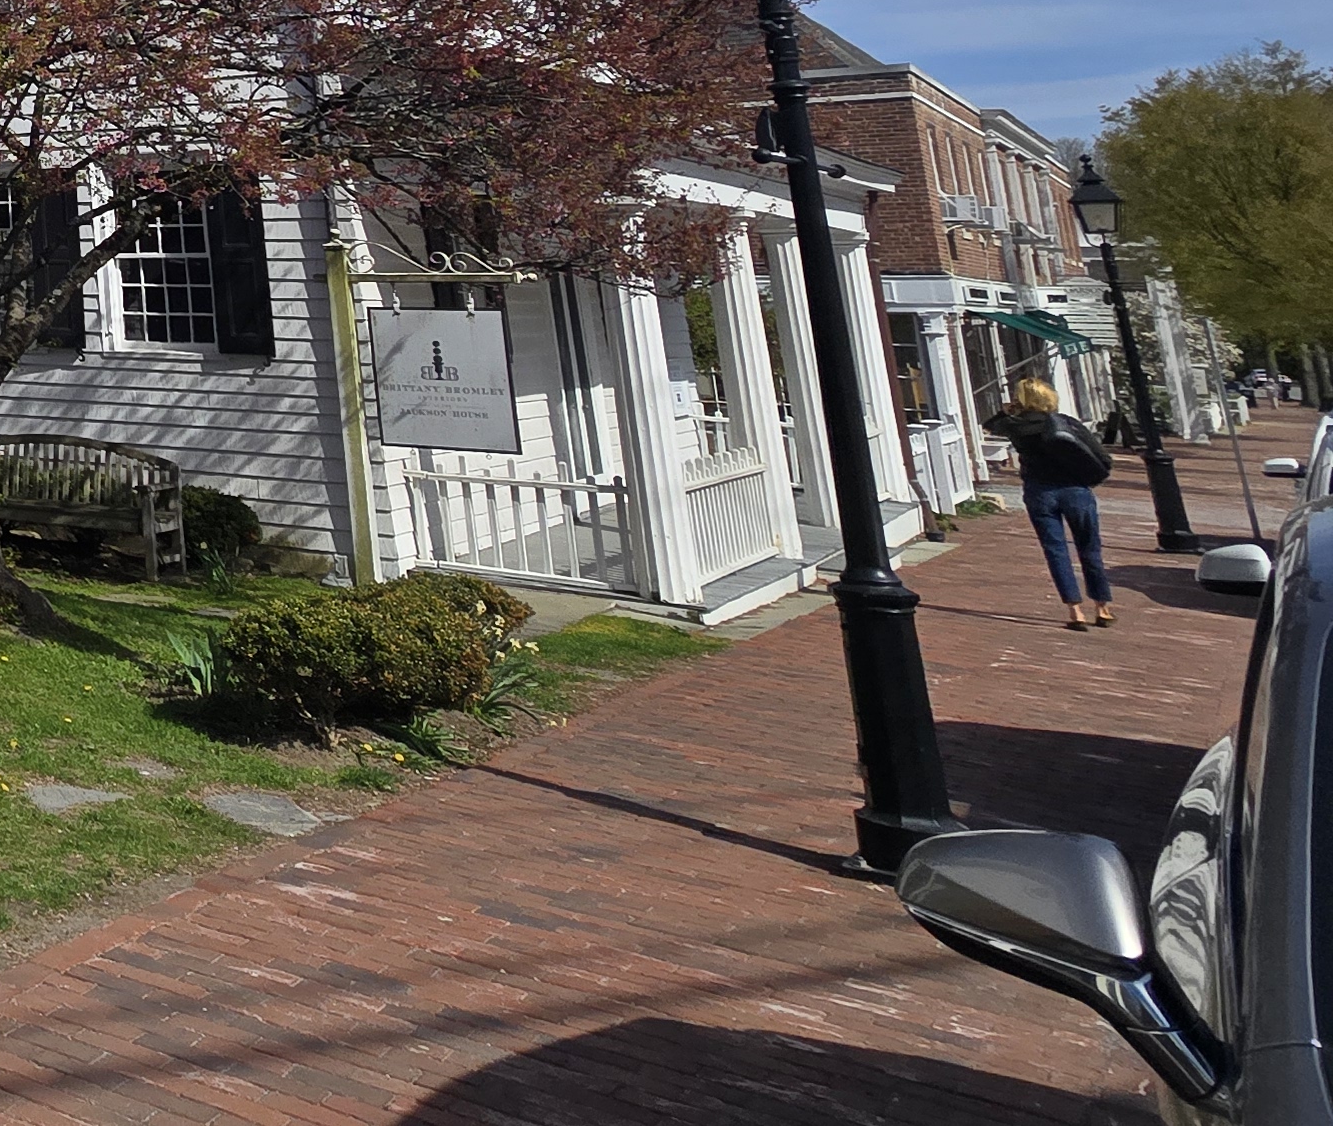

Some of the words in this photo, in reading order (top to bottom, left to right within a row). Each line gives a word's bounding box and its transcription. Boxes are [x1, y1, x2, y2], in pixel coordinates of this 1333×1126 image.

[383, 383, 442, 394] BRITTANY
[445, 386, 505, 396] BROMLEY
[400, 407, 449, 418] JACKSON
[453, 410, 490, 420] HOUSE
